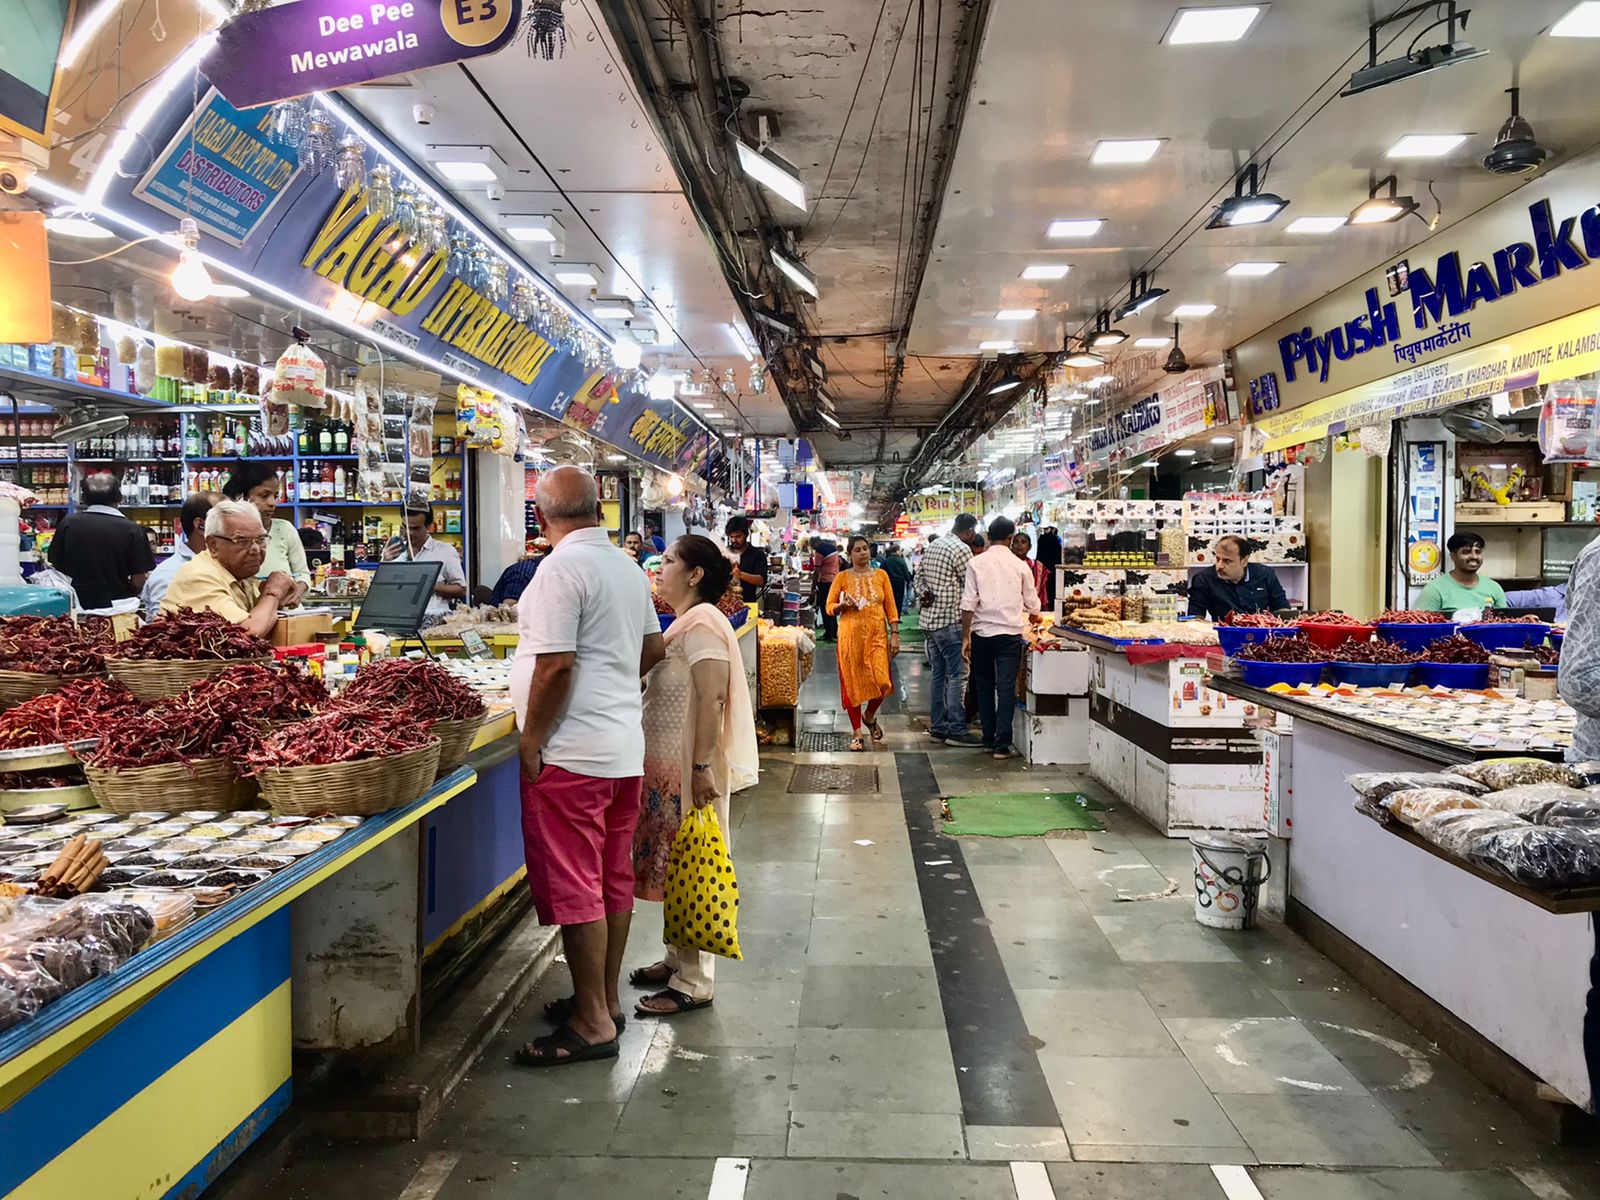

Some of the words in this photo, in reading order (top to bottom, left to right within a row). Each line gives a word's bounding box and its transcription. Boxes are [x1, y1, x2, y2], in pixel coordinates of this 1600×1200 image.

[318, 13, 364, 37] Dee
[371, 2, 415, 26] Pee
[455, 0, 497, 25] E3
[290, 30, 419, 74] Mewawala
[194, 109, 237, 154] VAGAD
[222, 131, 262, 170] MART
[263, 159, 293, 190] LTD
[176, 148, 267, 213] DISTRIBUTORS
[301, 180, 449, 316] VAGAD
[420, 277, 555, 385] INTERNATIONAL
[1413, 362, 1449, 383] Delivery
[1511, 346, 1554, 373] KAMOTHE,
[1469, 379, 1505, 398] SUPPLIER
